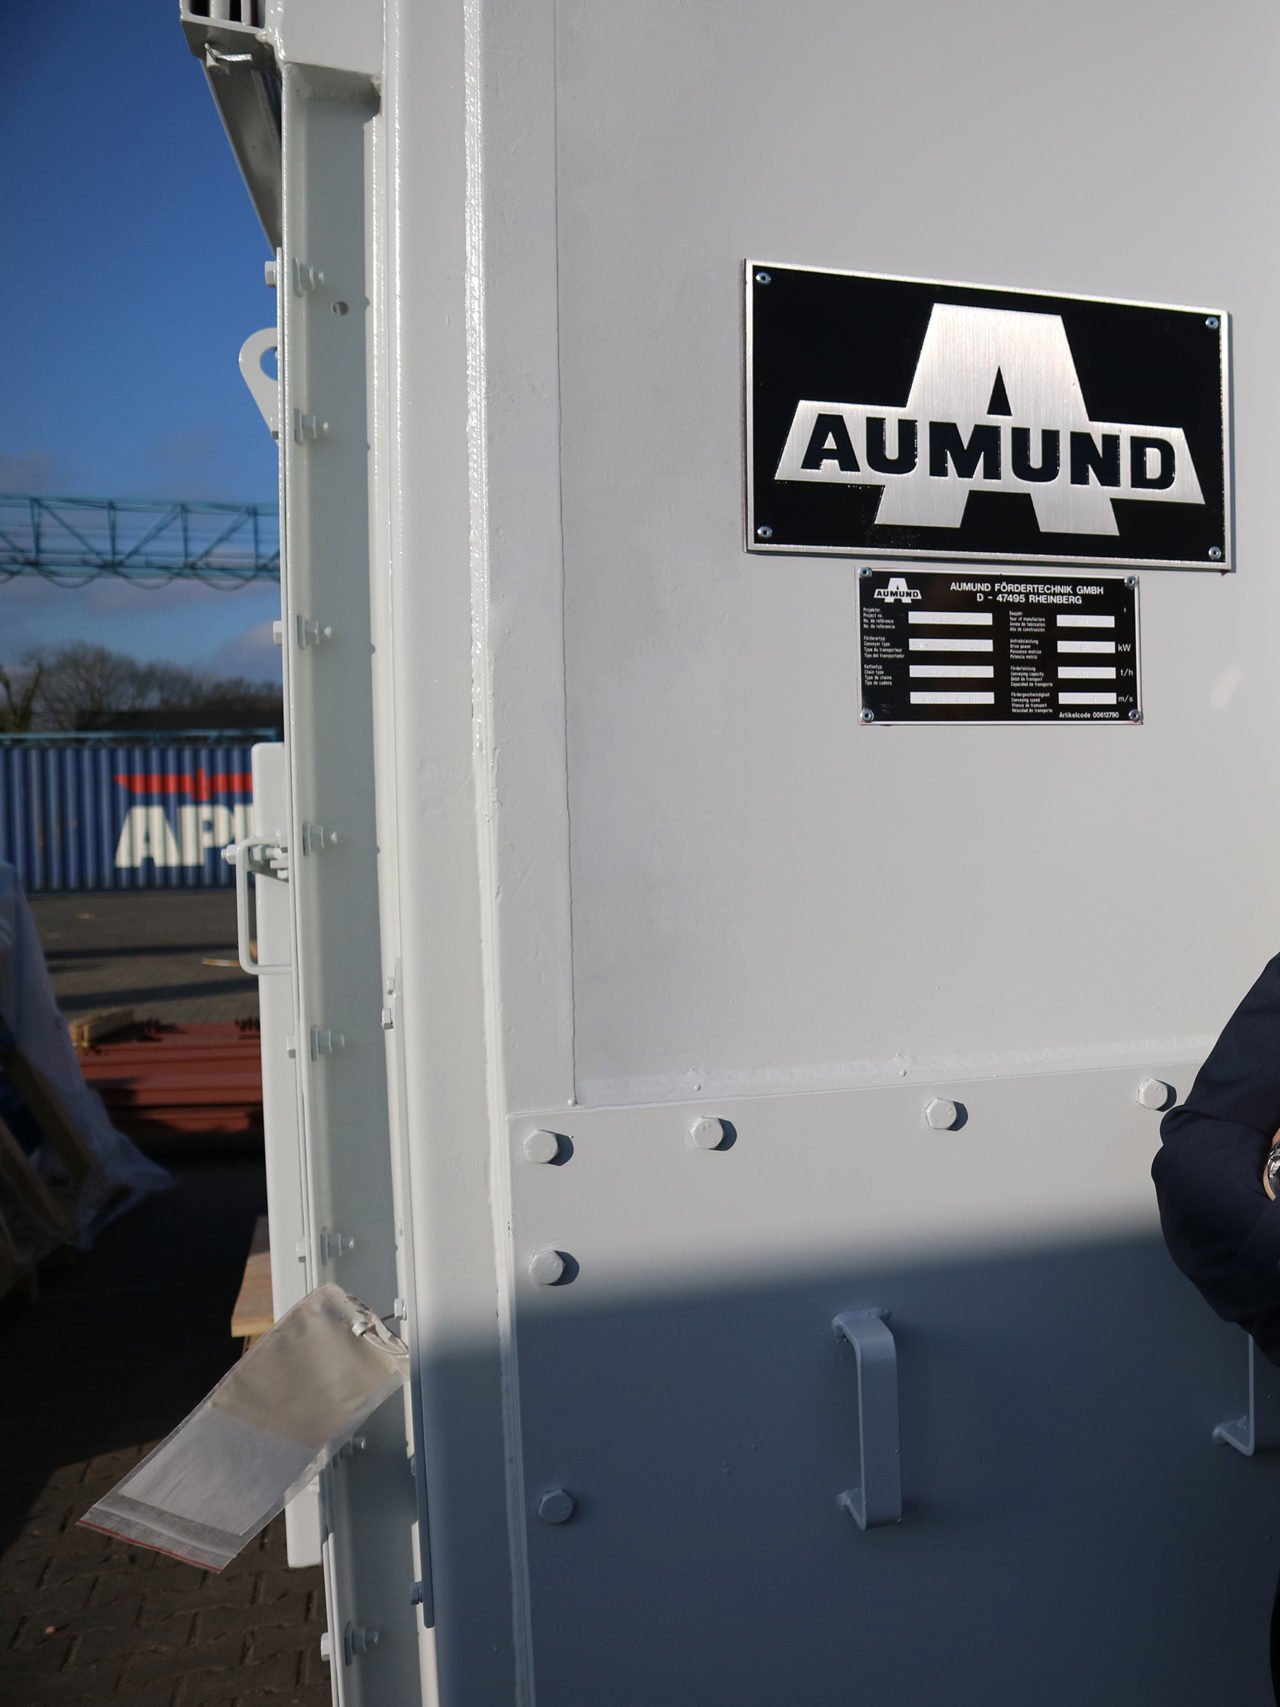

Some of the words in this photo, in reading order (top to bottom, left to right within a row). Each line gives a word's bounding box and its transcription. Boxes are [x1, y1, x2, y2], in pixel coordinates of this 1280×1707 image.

[799, 413, 1177, 491] AUMUND
[950, 582, 992, 592] AUMUND
[994, 581, 1073, 594] FÖRDERTECHNIK
[1076, 585, 1104, 595] GMBH
[876, 590, 919, 598] AUMUND
[976, 593, 984, 602] D
[996, 594, 1026, 603] 47495
[1029, 595, 1083, 605] RHEINBERG
[1117, 643, 1132, 652] kW
[1120, 667, 1134, 677] t/h
[1117, 694, 1134, 703] m/s
